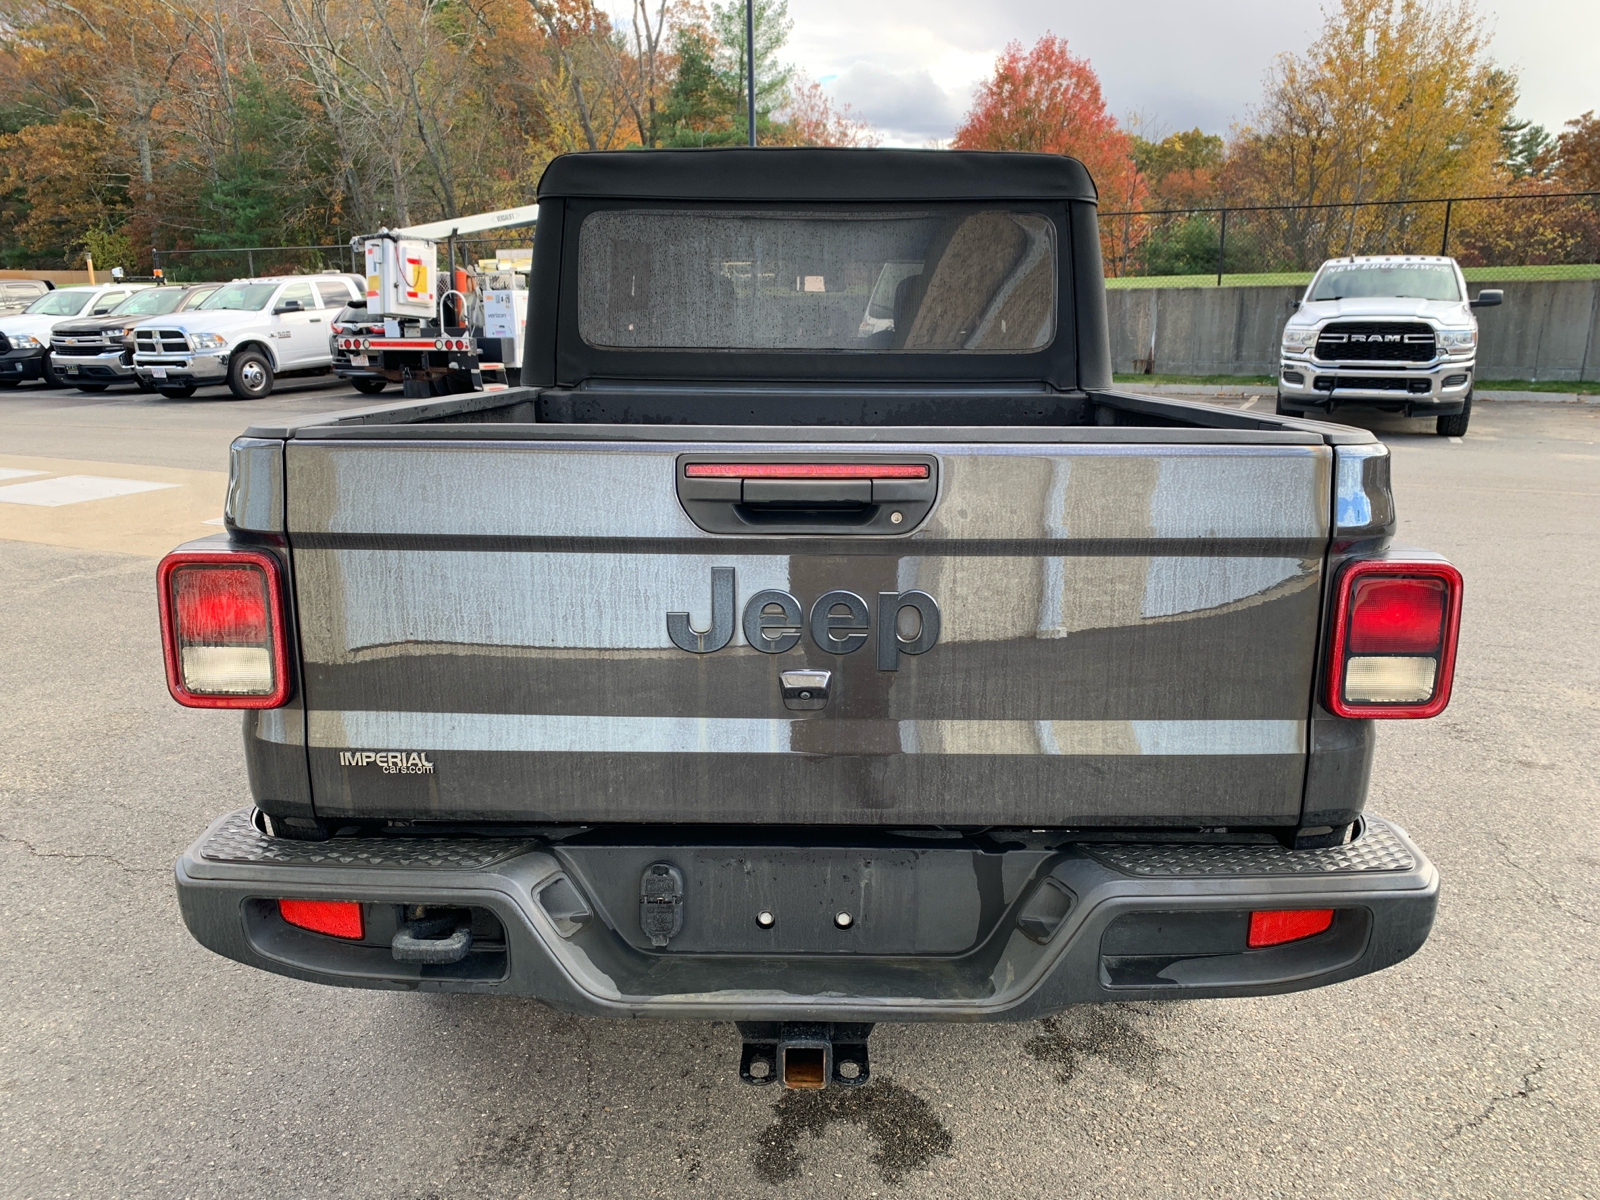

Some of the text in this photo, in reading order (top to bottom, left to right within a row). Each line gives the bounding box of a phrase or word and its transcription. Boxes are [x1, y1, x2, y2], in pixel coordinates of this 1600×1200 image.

[1327, 264, 1360, 273] NEW
[1351, 334, 1401, 342] RAM
[666, 566, 941, 672] Jeep
[340, 751, 434, 767] IMPERIAL
[382, 765, 434, 774] cars.com
